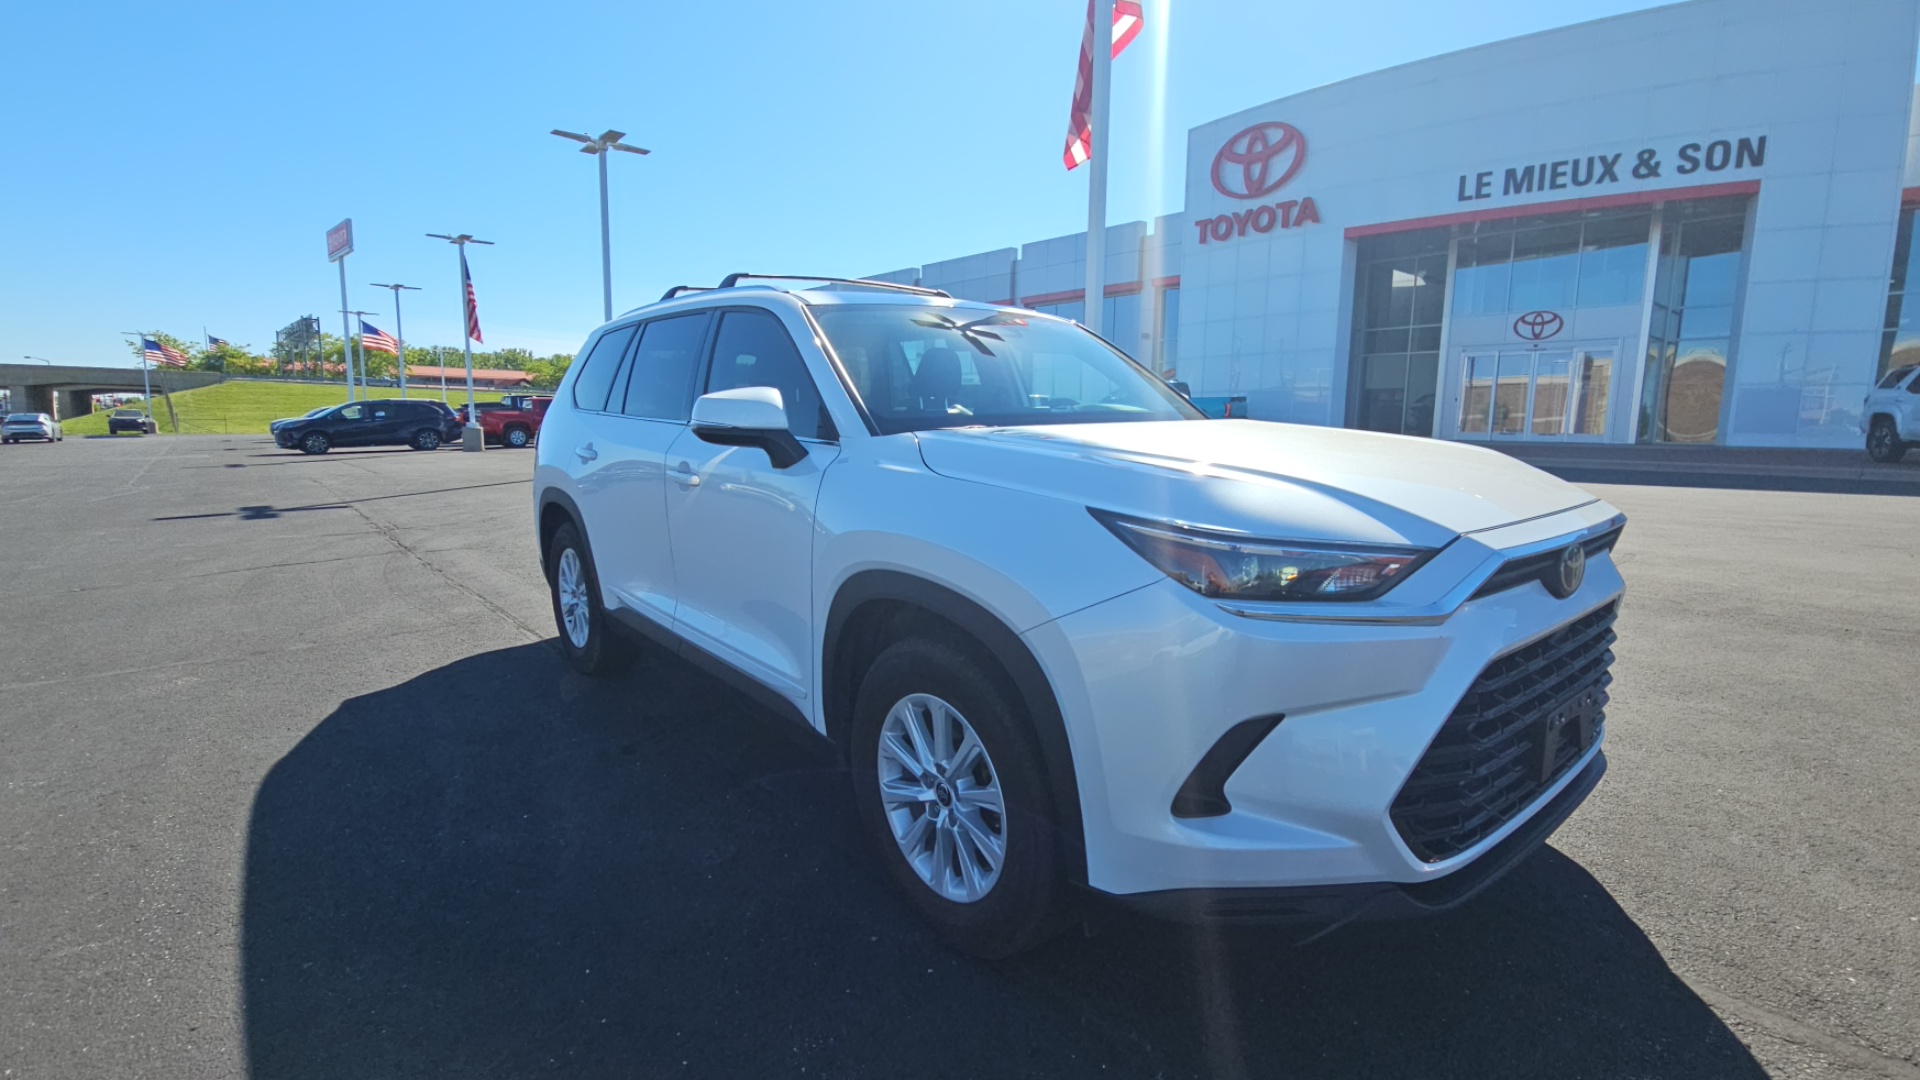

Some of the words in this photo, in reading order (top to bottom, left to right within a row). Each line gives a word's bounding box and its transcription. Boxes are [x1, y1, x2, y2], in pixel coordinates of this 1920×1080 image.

[1457, 171, 1494, 202] LE
[1502, 153, 1623, 196] MIEUX
[1631, 148, 1662, 179] &
[1676, 135, 1767, 175] SON
[1194, 196, 1320, 245] TOYOTA
